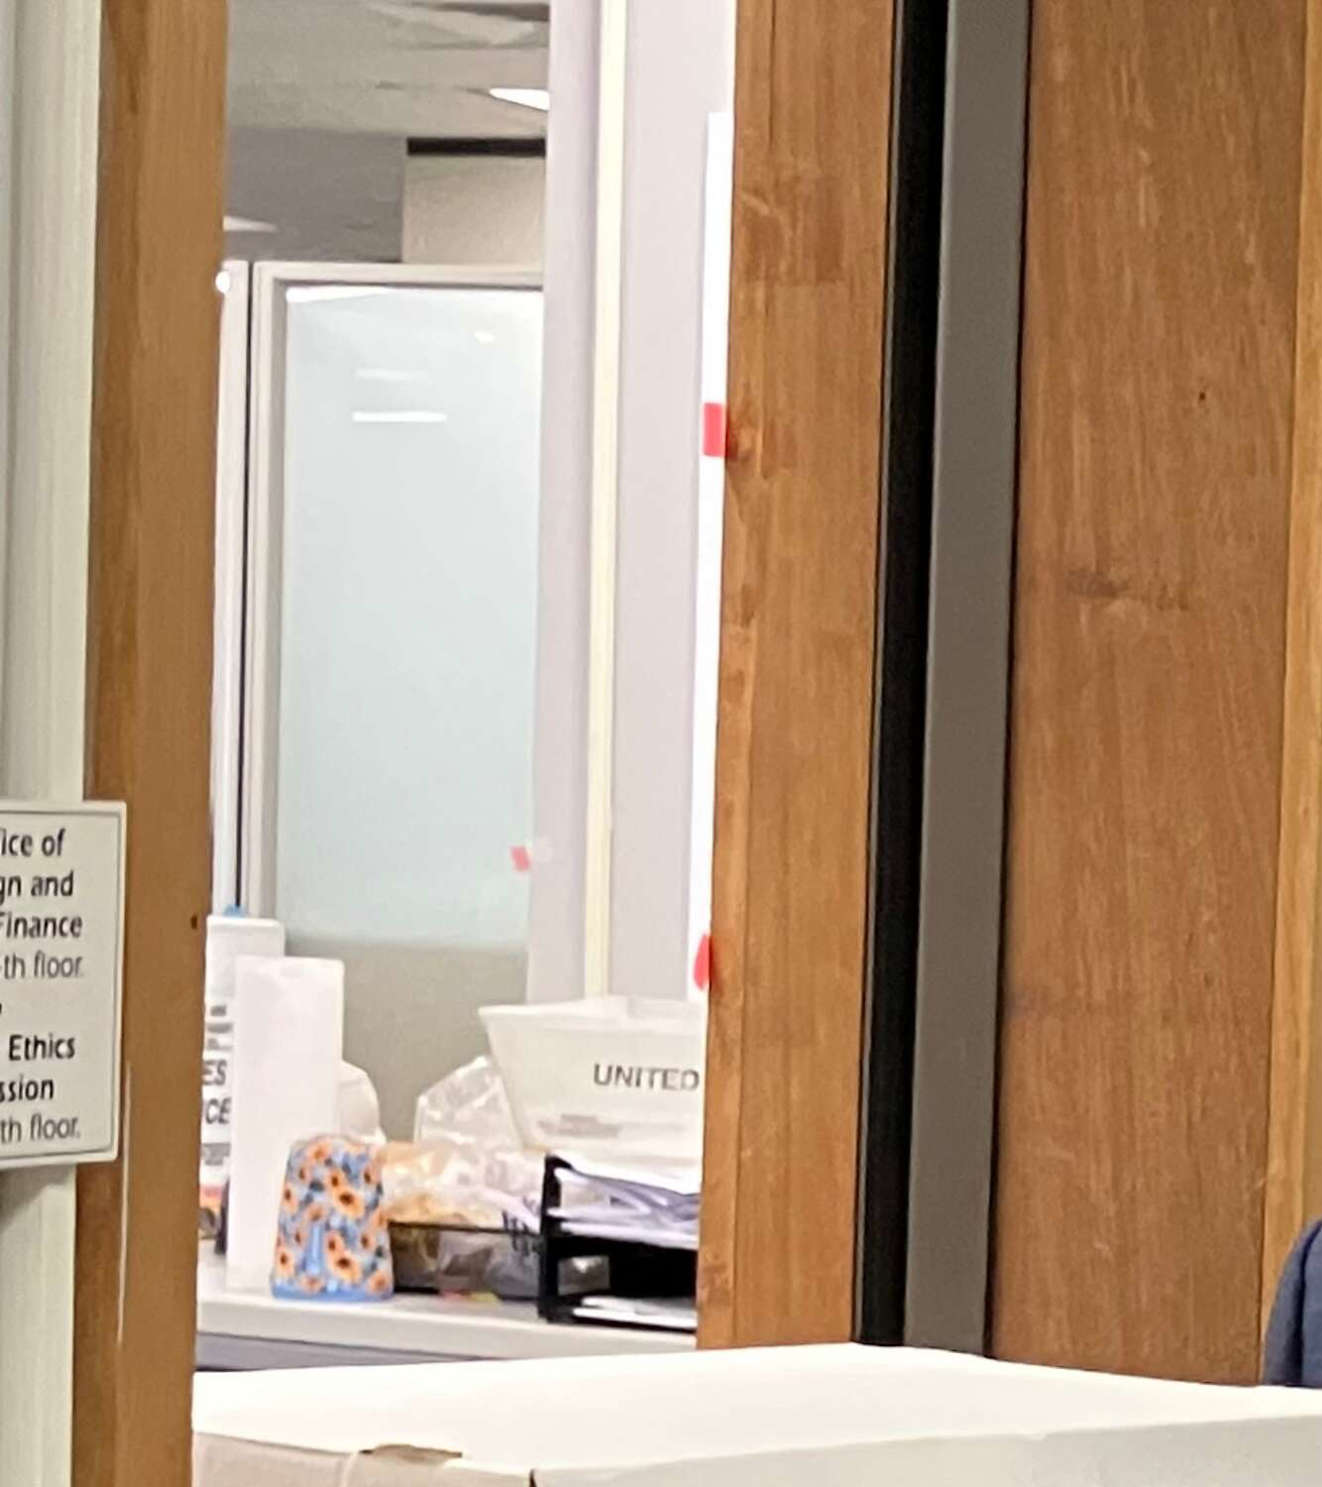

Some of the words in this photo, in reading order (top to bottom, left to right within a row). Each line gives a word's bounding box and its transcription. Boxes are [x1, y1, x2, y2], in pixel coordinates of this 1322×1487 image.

[41, 827, 66, 857] of
[30, 868, 74, 897] and
[8, 1031, 76, 1062] Ethics
[593, 1063, 701, 1092] UNITED
